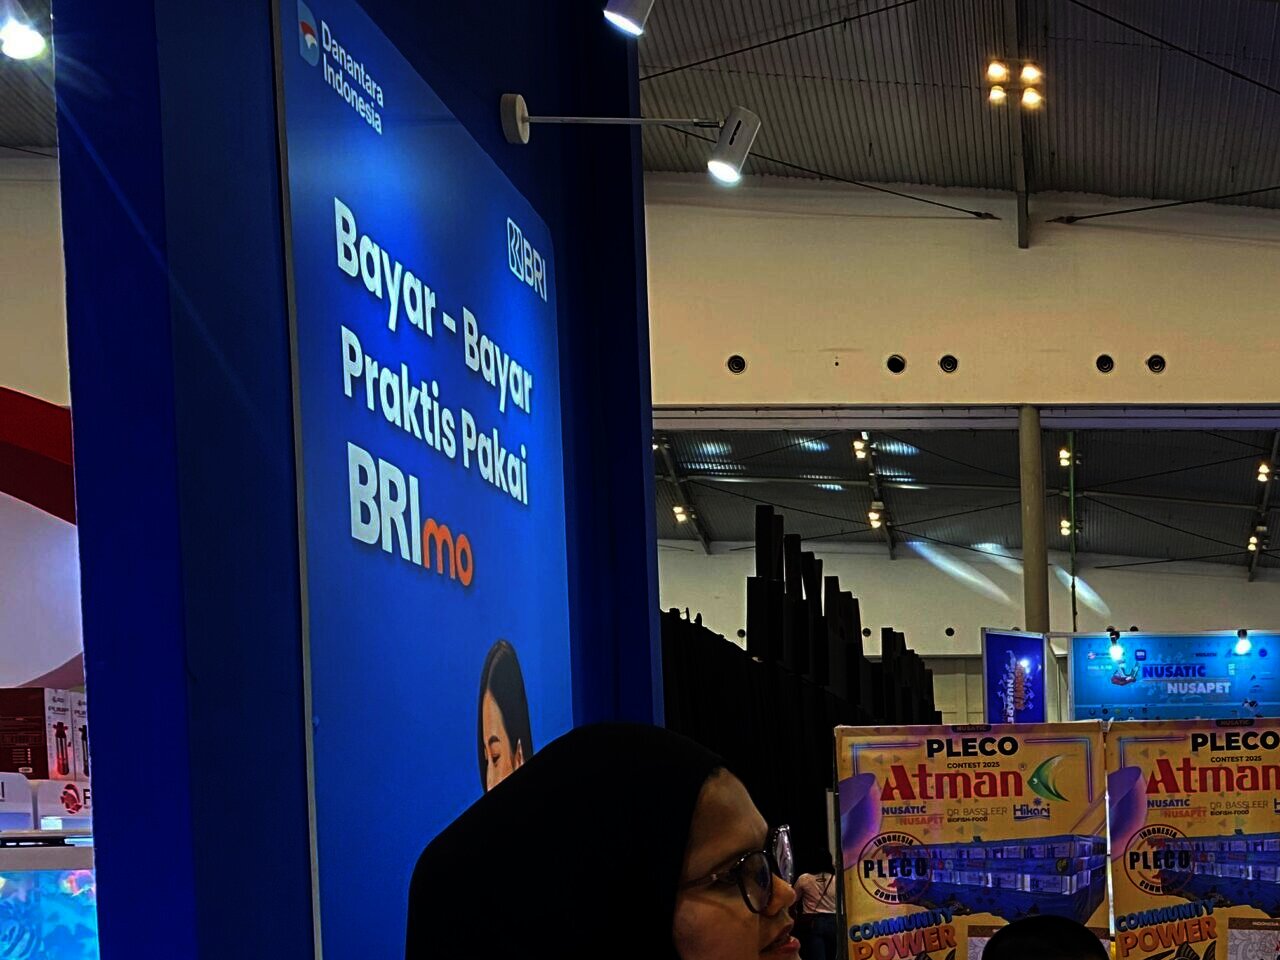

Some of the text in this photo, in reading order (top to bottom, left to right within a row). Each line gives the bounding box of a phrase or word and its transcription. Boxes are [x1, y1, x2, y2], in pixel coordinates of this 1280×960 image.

[321, 19, 384, 108] Danantara
[322, 53, 383, 135] Indonesia
[523, 232, 548, 303] BRI
[334, 196, 436, 332] Bayar
[462, 306, 533, 415] Bayar
[341, 324, 529, 506] Praktis Pakai
[347, 440, 474, 588] BRImo
[1142, 665, 1206, 678] NUSATIC
[1167, 682, 1231, 694] NUSAPET
[926, 736, 1018, 758] PLECO
[1191, 731, 1280, 752] PLECO
[880, 764, 1023, 800] Atman
[881, 805, 927, 814] NUSATIC
[963, 807, 1007, 815] BASSLEER
[1013, 804, 1050, 817] Hikari
[1147, 799, 1190, 808] NUSATIC
[1163, 810, 1207, 818] NUSAPET
[900, 816, 944, 825] NUSAPET
[873, 834, 914, 848] INDONESIA
[1139, 827, 1177, 839] INDONESIA
[863, 857, 928, 879] PLECO
[1129, 849, 1191, 870] PLECO
[849, 907, 954, 943] COMMUNITY
[1115, 899, 1215, 932] COMMUNITY
[1119, 916, 1218, 957] POWER
